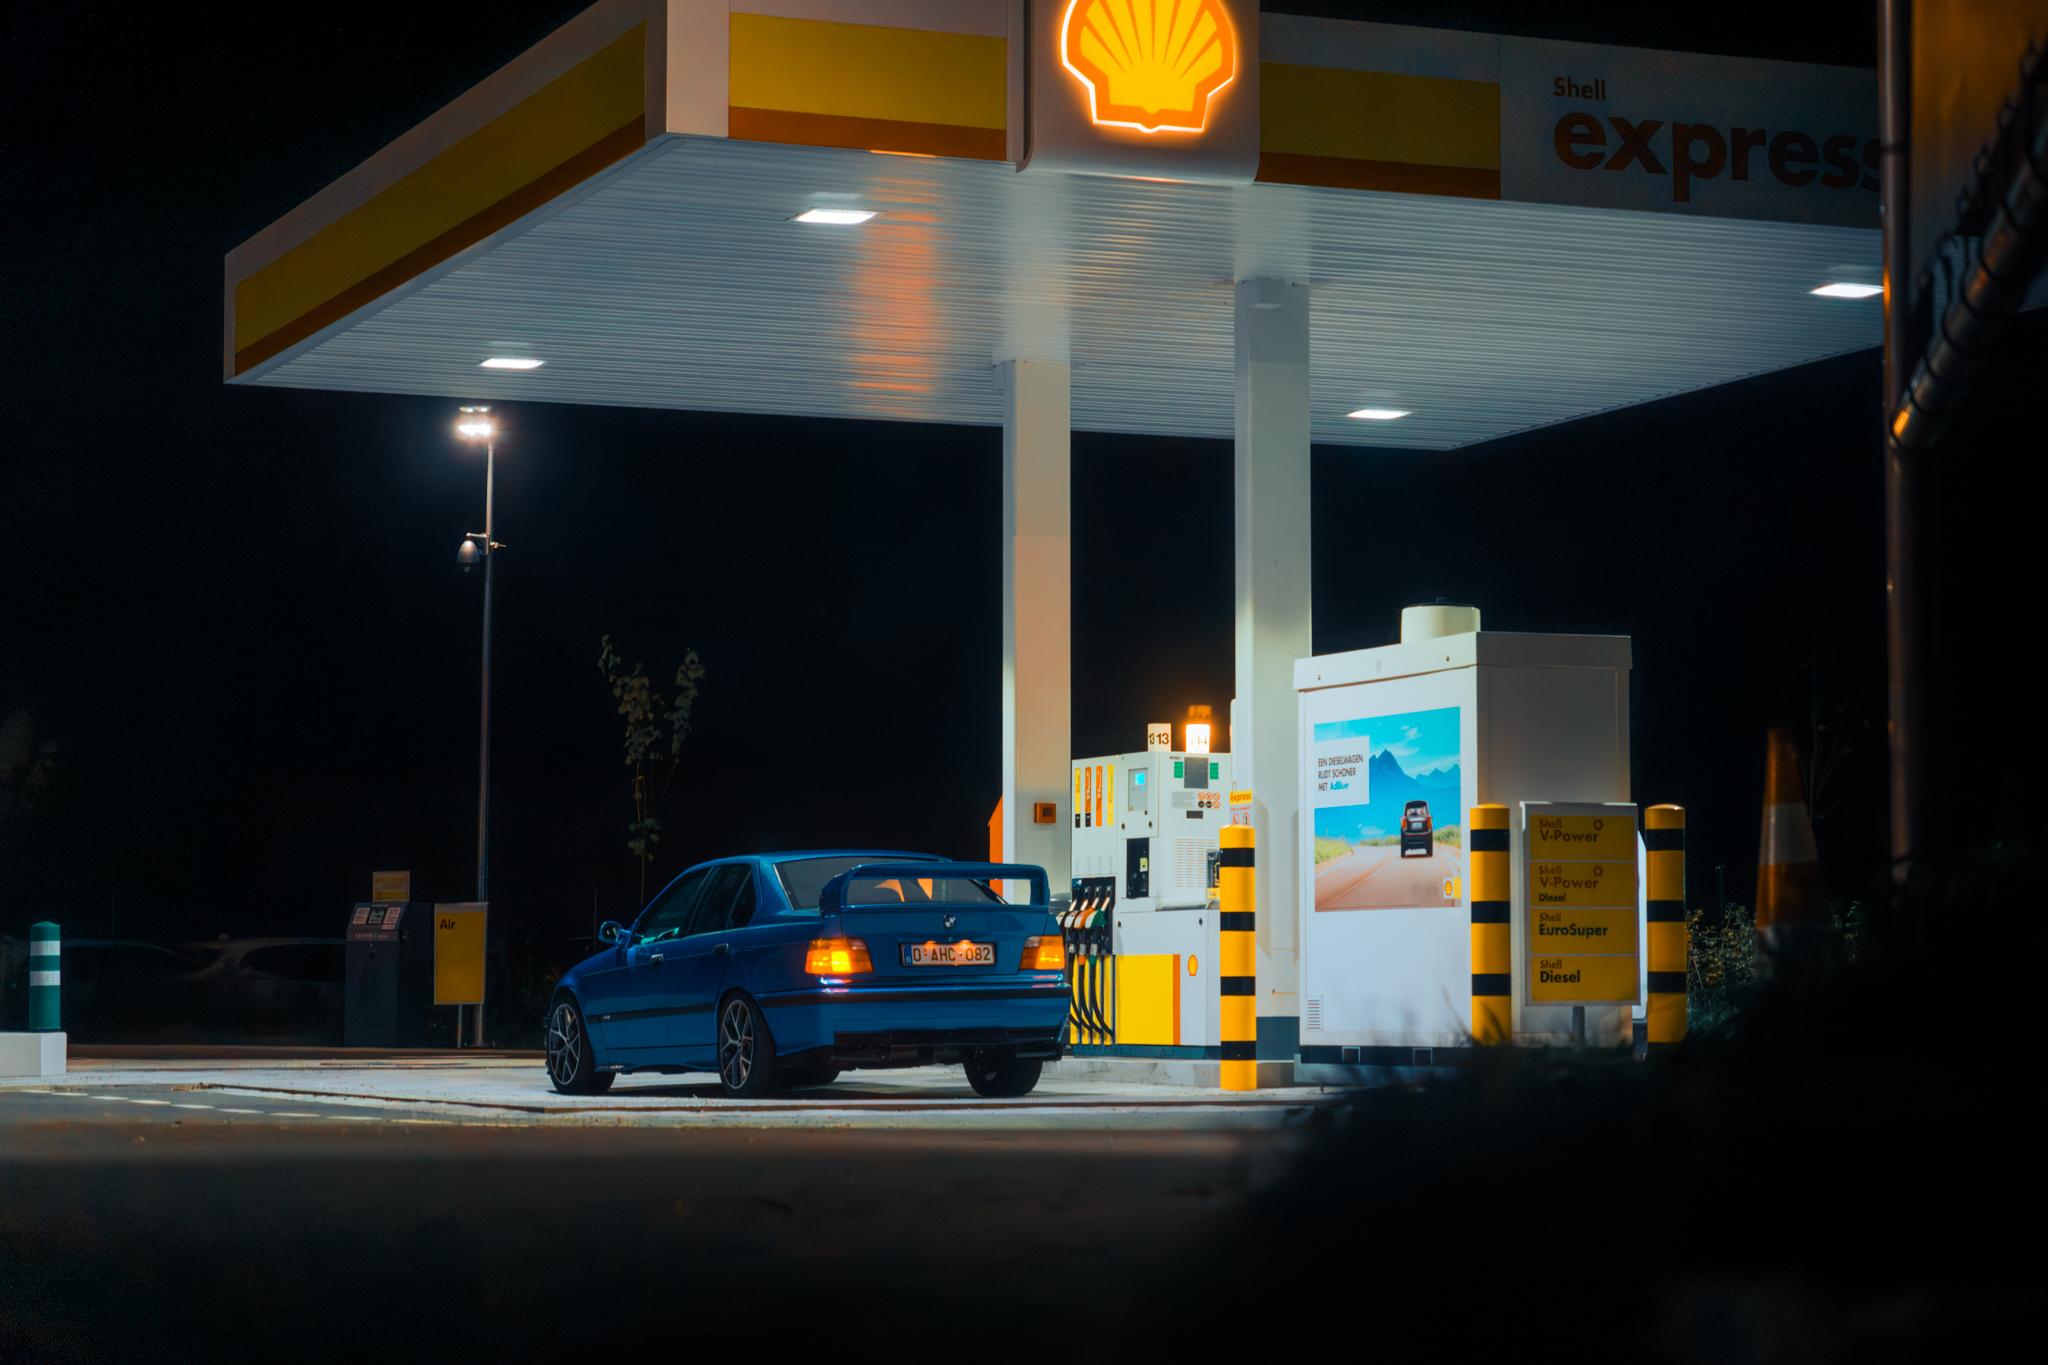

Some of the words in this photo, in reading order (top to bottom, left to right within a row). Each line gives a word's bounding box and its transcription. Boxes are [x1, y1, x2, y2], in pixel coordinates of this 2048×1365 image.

[1553, 76, 1606, 101] Shell
[1156, 732, 1169, 745] 13
[1318, 757, 1328, 767] EEN
[1328, 754, 1363, 766] DIESELWAGEN
[1332, 768, 1356, 778] SCHONER
[1318, 782, 1328, 792] MET
[1539, 818, 1562, 829] Shell
[1540, 829, 1600, 842] V-Power
[1539, 864, 1562, 875] Shell
[1540, 876, 1599, 889] V-Power
[1539, 892, 1567, 902] Diesel
[1539, 912, 1562, 922] Shell
[440, 919, 456, 930] Air
[1539, 923, 1609, 940] EuroSuper
[1540, 959, 1562, 969] Shell
[1540, 969, 1581, 983] Diesel
